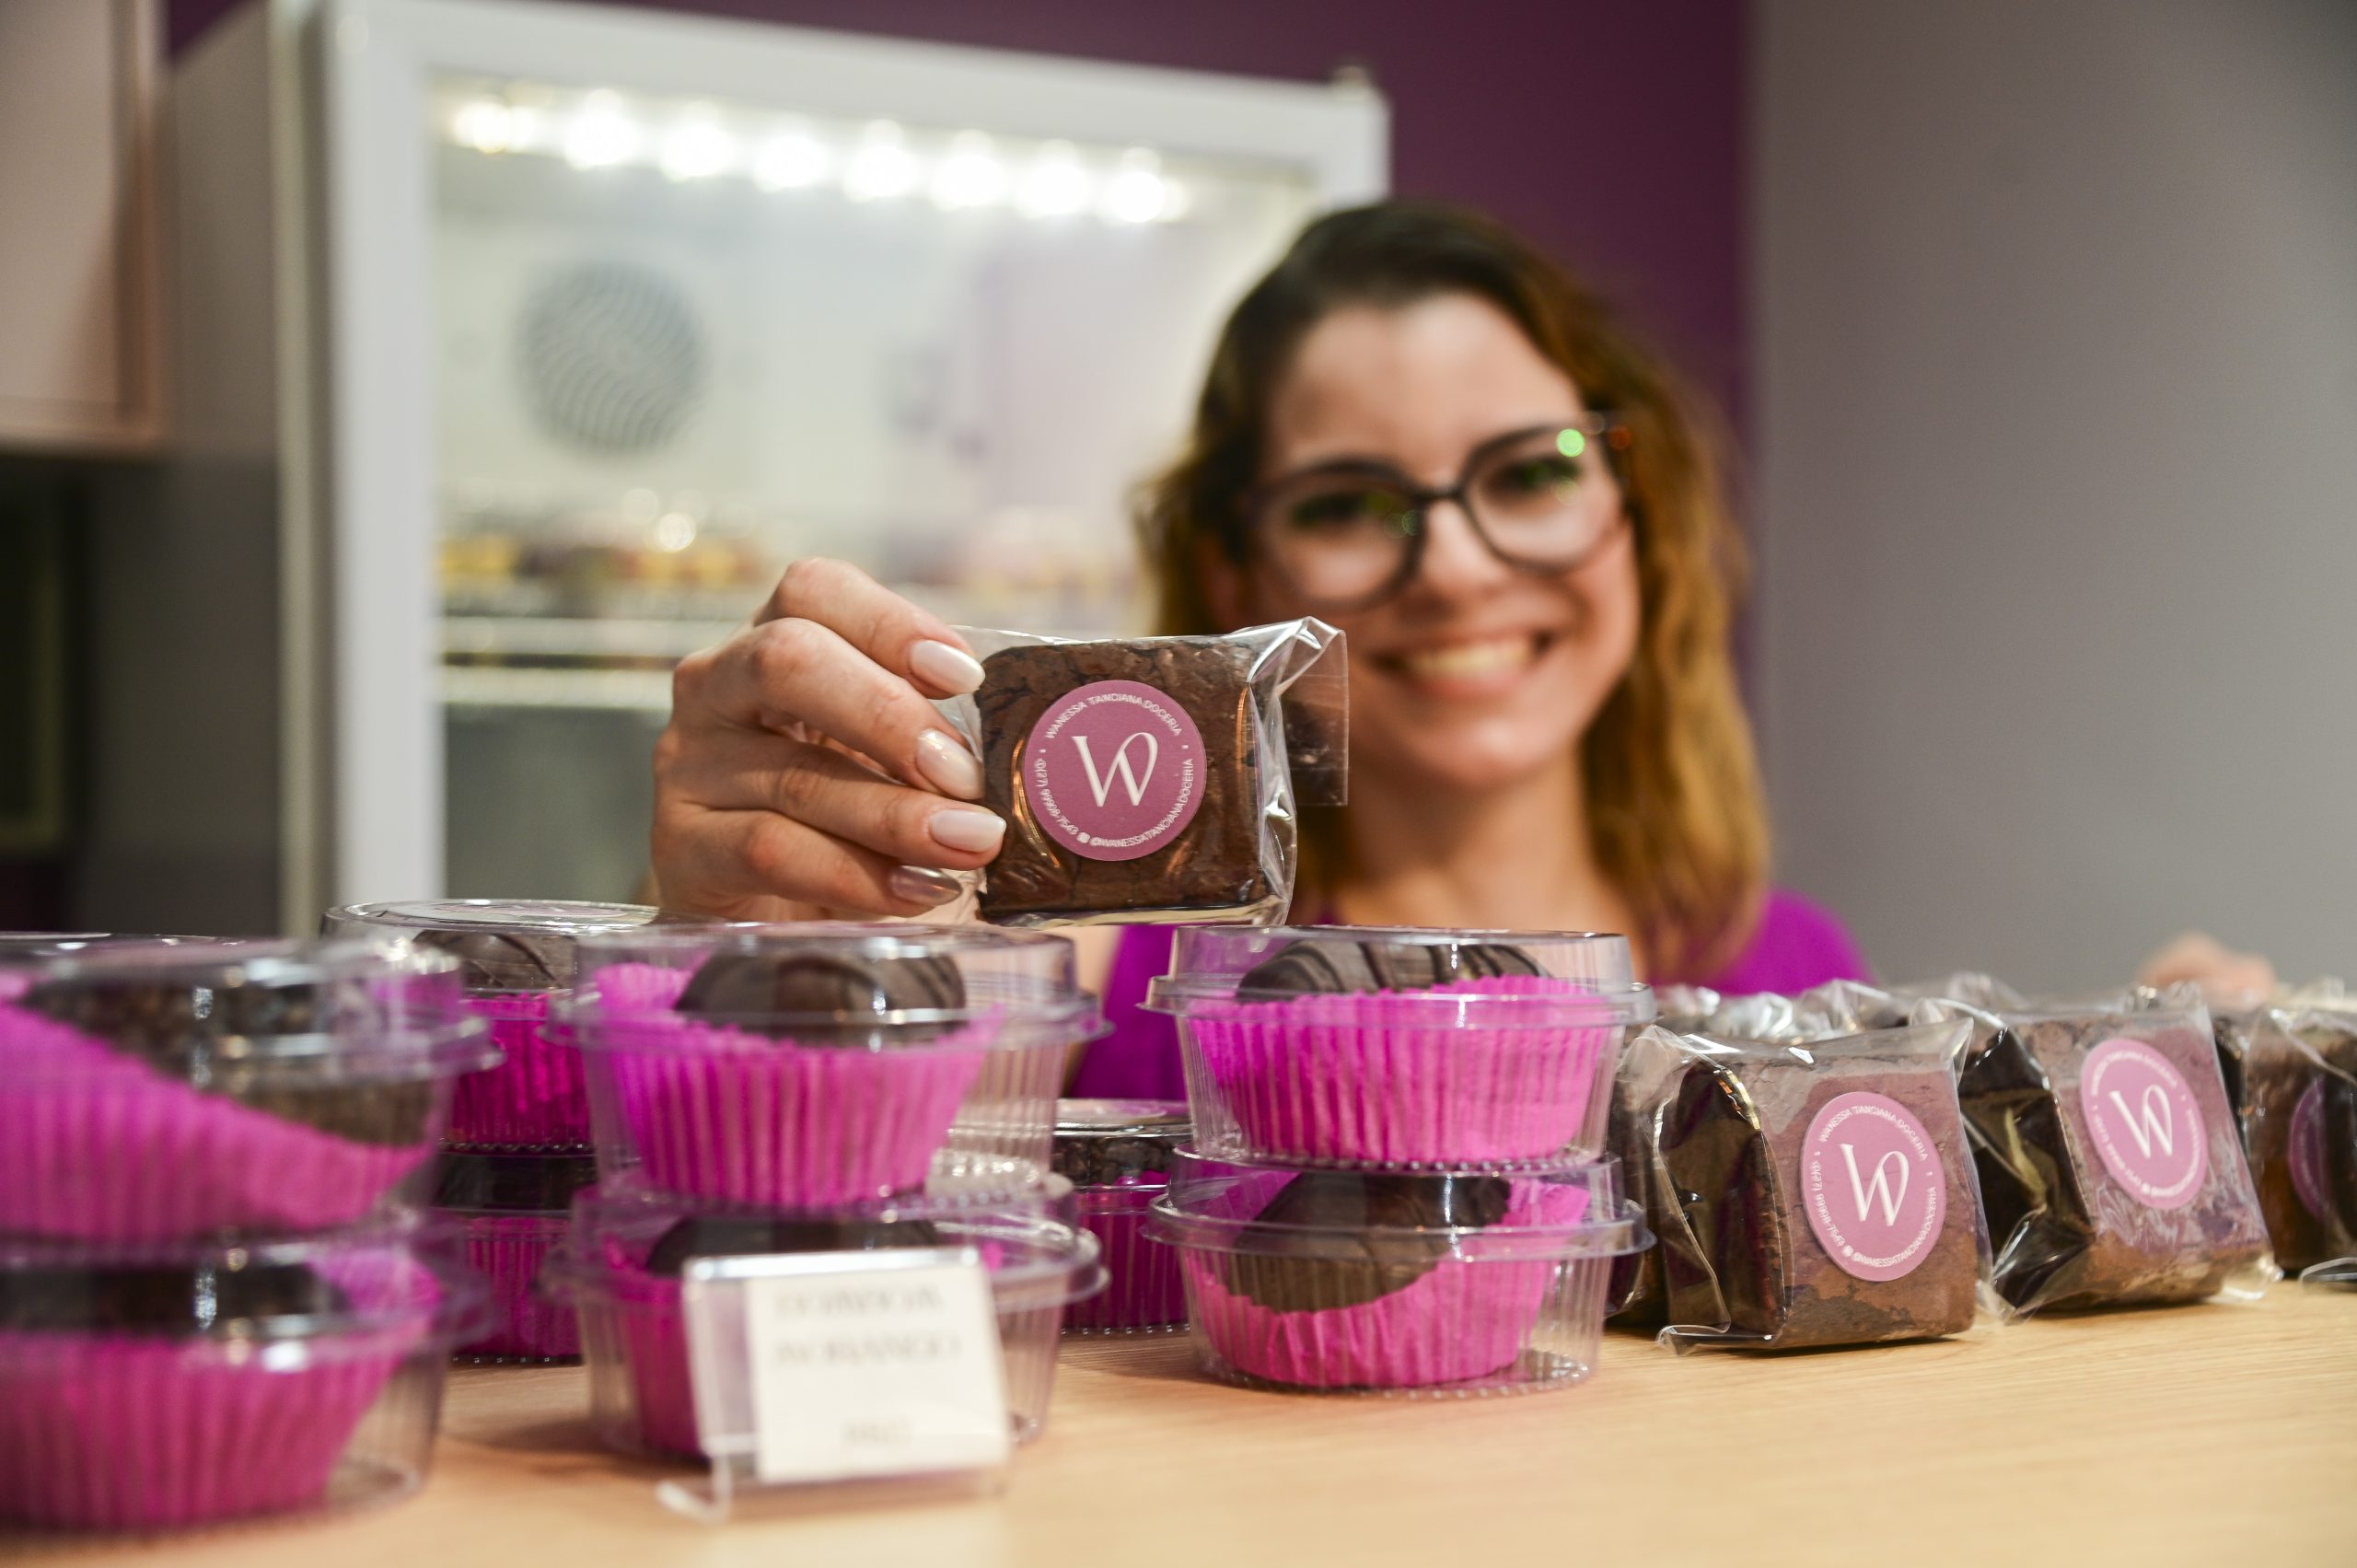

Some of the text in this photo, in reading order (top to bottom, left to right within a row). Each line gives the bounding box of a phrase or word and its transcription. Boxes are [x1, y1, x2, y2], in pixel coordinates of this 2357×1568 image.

[1045, 692, 1182, 738] WANESSA TANCIANA DOCERIA
[1071, 732, 1158, 807] W
[1818, 1105, 1929, 1162] WANESSA TANCIANA DOCERIA
[2108, 1084, 2173, 1159] W
[1840, 1144, 1910, 1227] W
